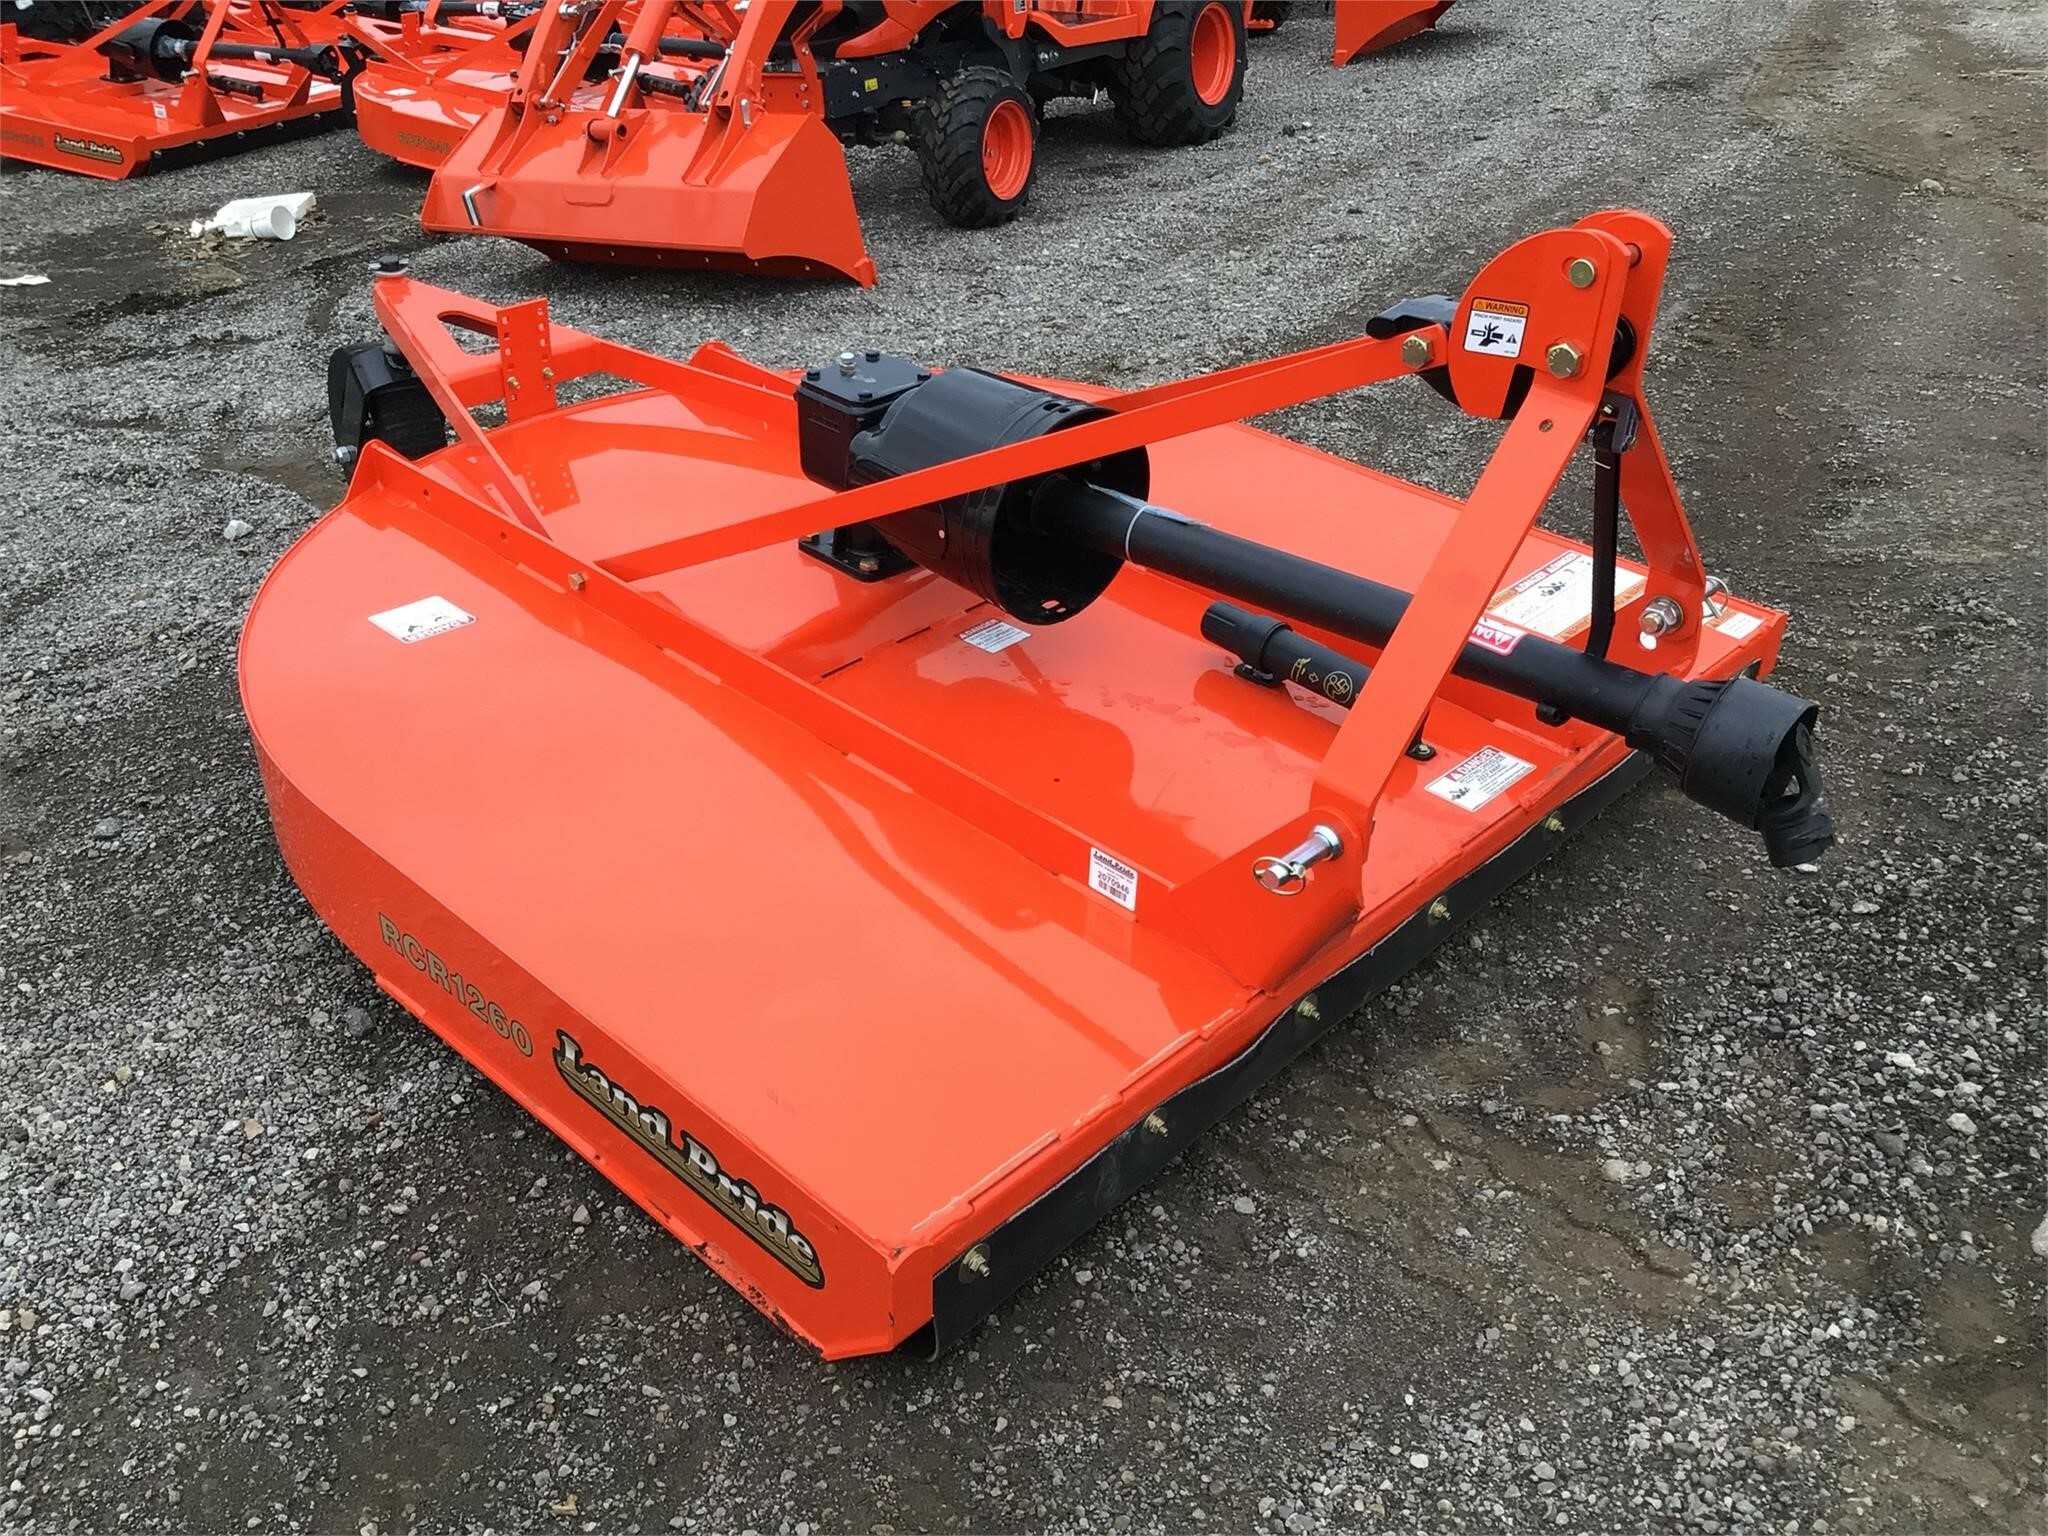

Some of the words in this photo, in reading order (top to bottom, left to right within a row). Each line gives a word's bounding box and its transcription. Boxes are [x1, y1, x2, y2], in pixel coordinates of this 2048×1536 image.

[1485, 302, 1525, 315] WARNING
[1503, 316, 1523, 324] HAZARD
[1459, 748, 1498, 774] DANGER
[1093, 850, 1113, 867] Land
[1112, 861, 1135, 880] Pride
[378, 912, 534, 1058] RCR1260
[553, 1030, 671, 1152] Land
[680, 1131, 819, 1270] Pride
